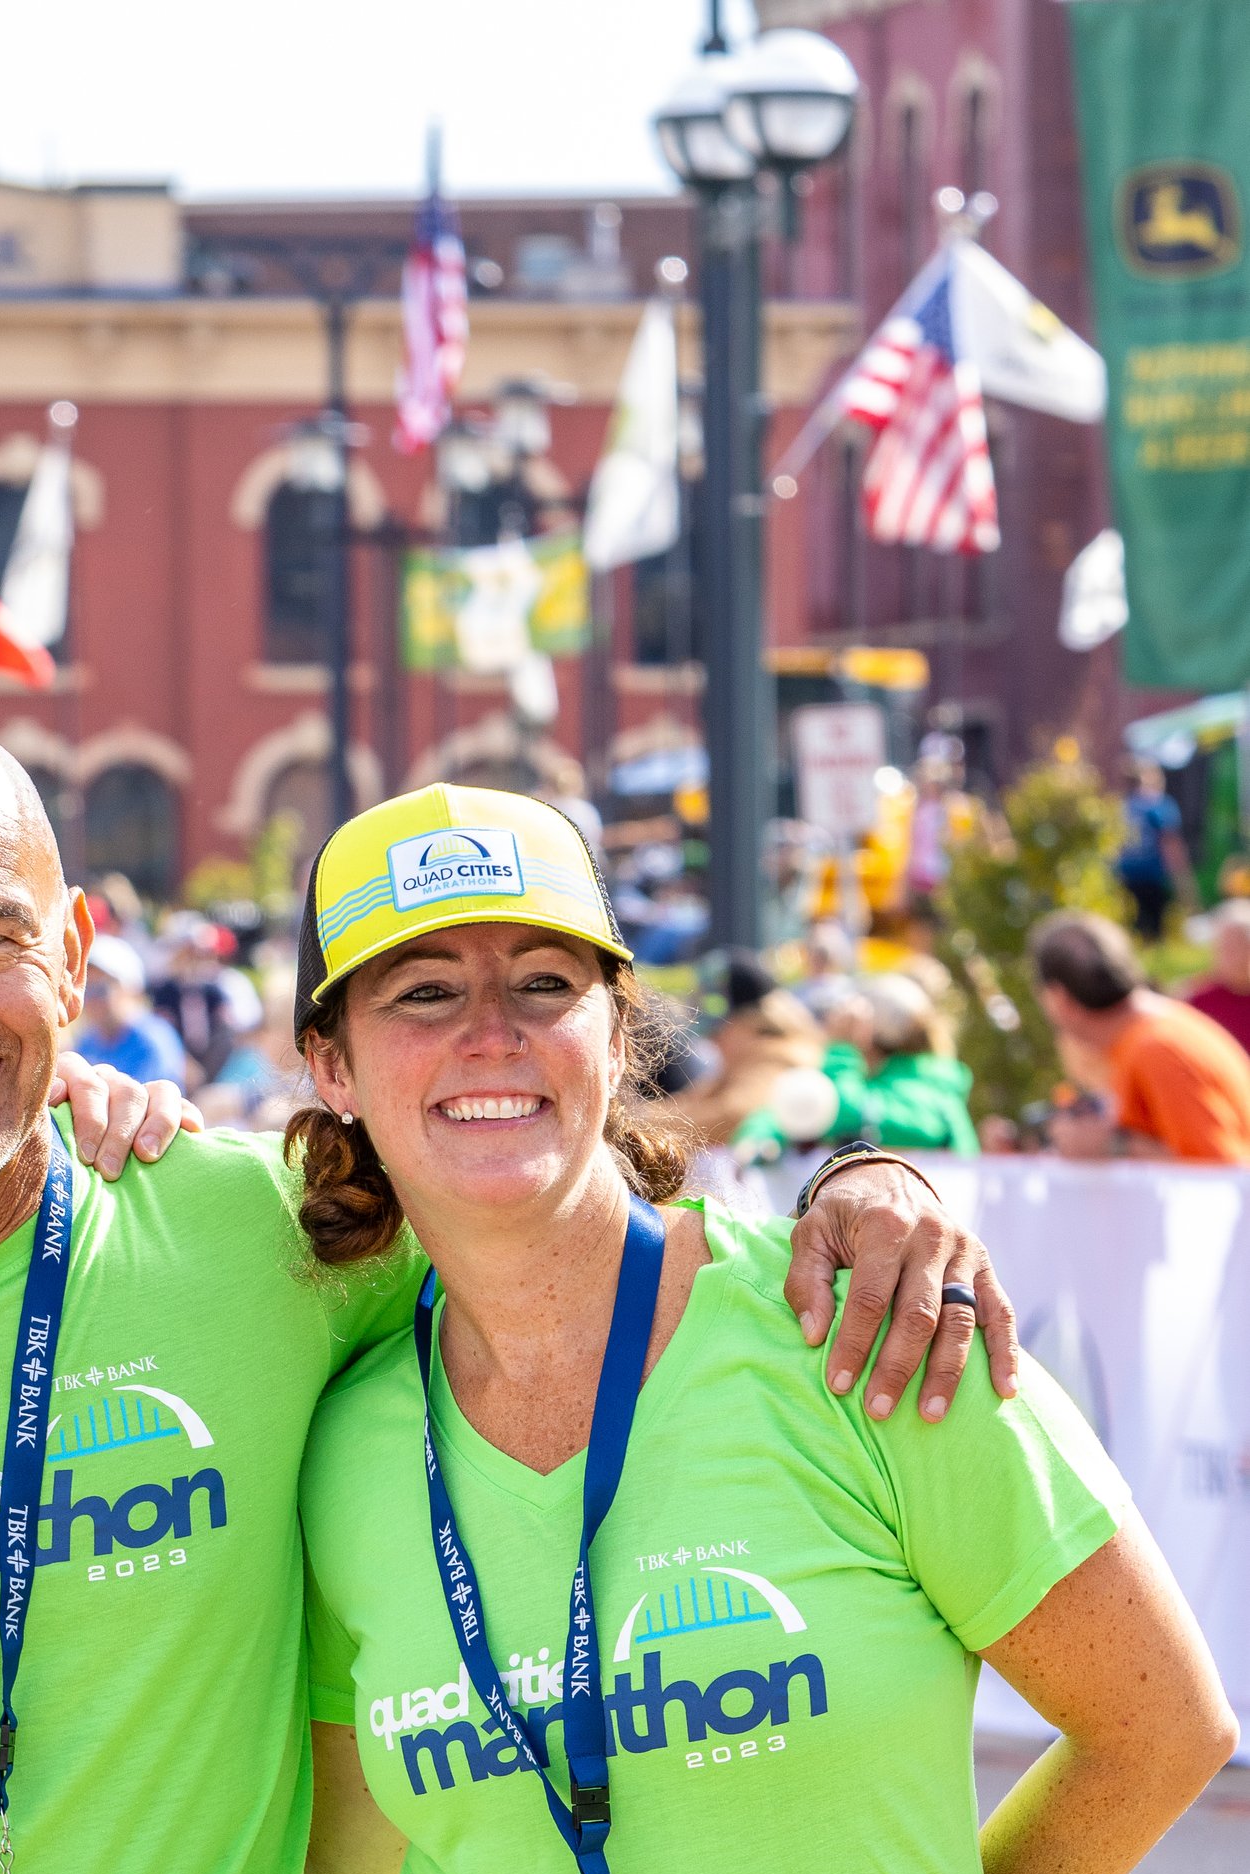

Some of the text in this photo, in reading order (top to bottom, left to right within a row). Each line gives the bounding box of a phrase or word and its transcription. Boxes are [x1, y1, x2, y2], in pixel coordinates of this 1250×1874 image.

[403, 864, 513, 891] QUAD CITIES
[422, 878, 497, 895] MARATHON
[41, 1201, 66, 1264] BANK
[15, 1314, 51, 1448] TBK BANK
[52, 1355, 160, 1394] TBK BANK
[6, 1504, 29, 1640] TBK BANK
[87, 1549, 188, 1582] 2023
[439, 1519, 479, 1646] TBK BANK
[635, 1540, 751, 1572] TBK BANK
[571, 1561, 591, 1699] TBK BANK
[370, 1661, 471, 1750] quad
[400, 1651, 828, 1795] marthon
[486, 1684, 523, 1748] BANK
[686, 1735, 786, 1769] 2023
